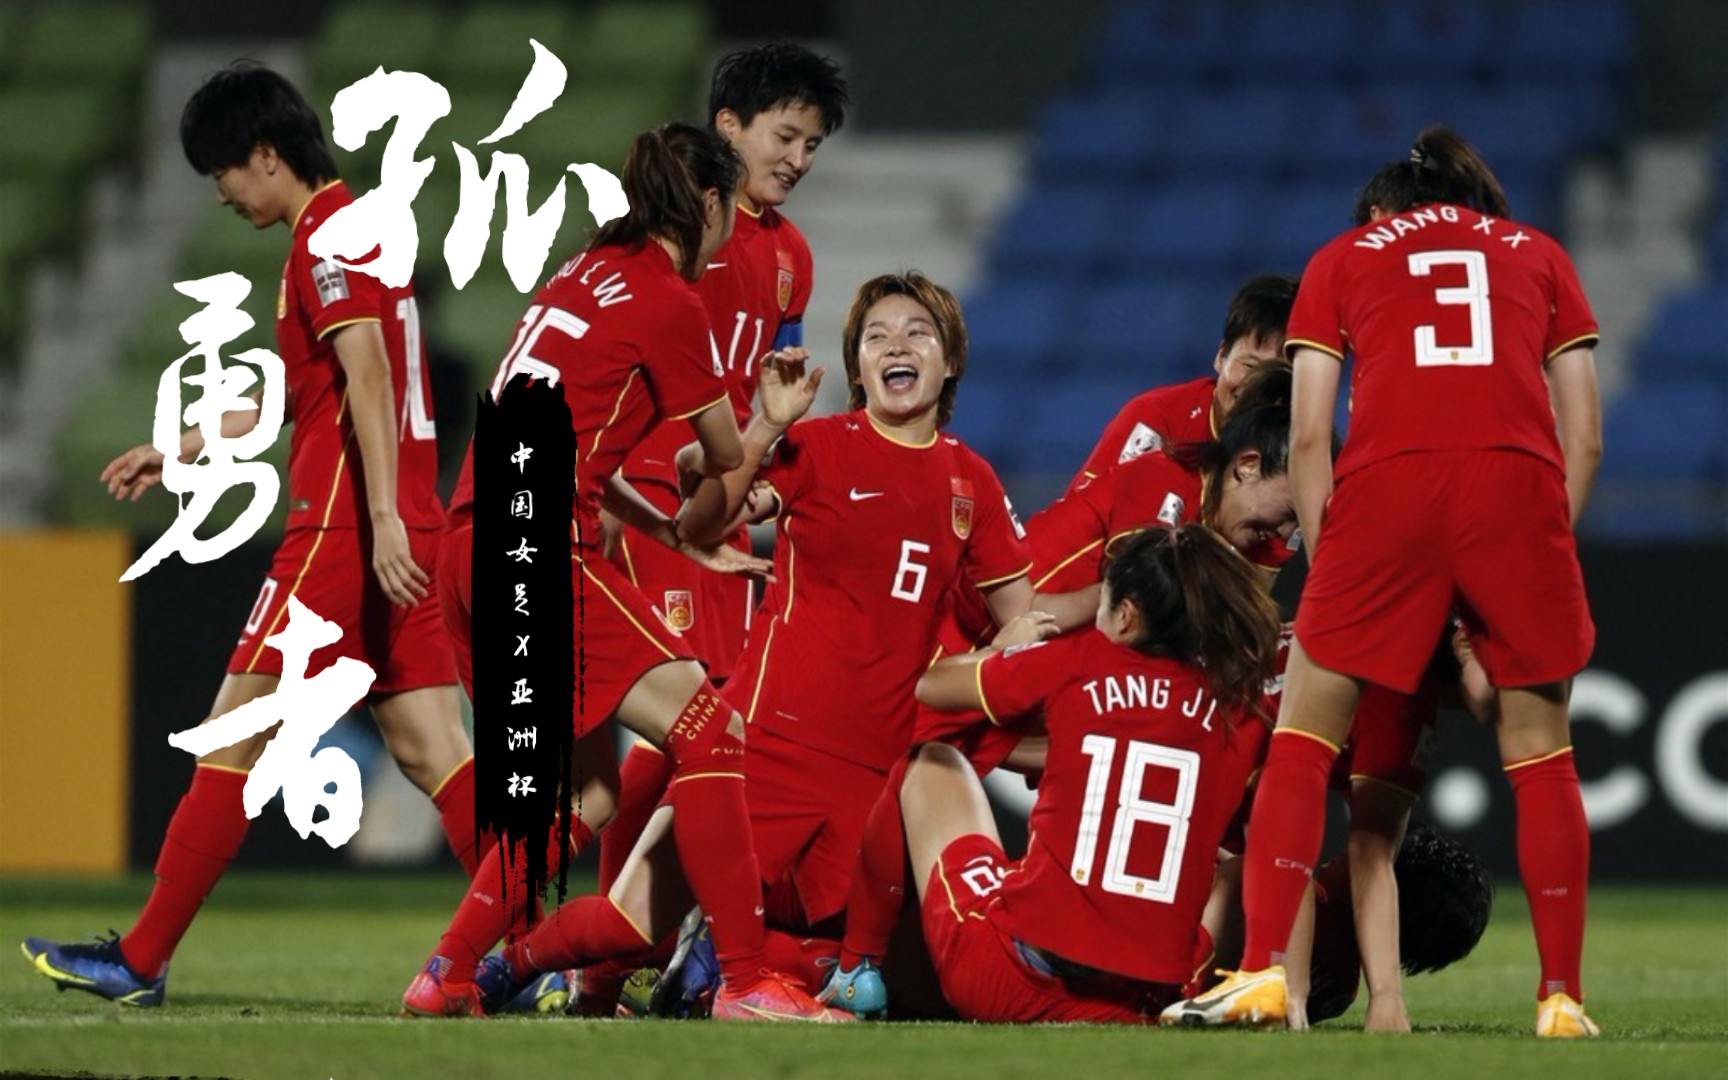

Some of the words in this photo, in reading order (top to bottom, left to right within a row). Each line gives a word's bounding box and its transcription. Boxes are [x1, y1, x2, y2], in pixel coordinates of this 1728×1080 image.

[1354, 206, 1459, 250] WANG
[1408, 250, 1494, 367] 3
[490, 304, 591, 405] 15
[728, 310, 764, 377] 11
[890, 538, 931, 604] 6
[668, 693, 708, 744] CHINA
[685, 696, 720, 740] CHINA
[1082, 674, 1171, 715] TANG
[1070, 734, 1200, 904] 18
